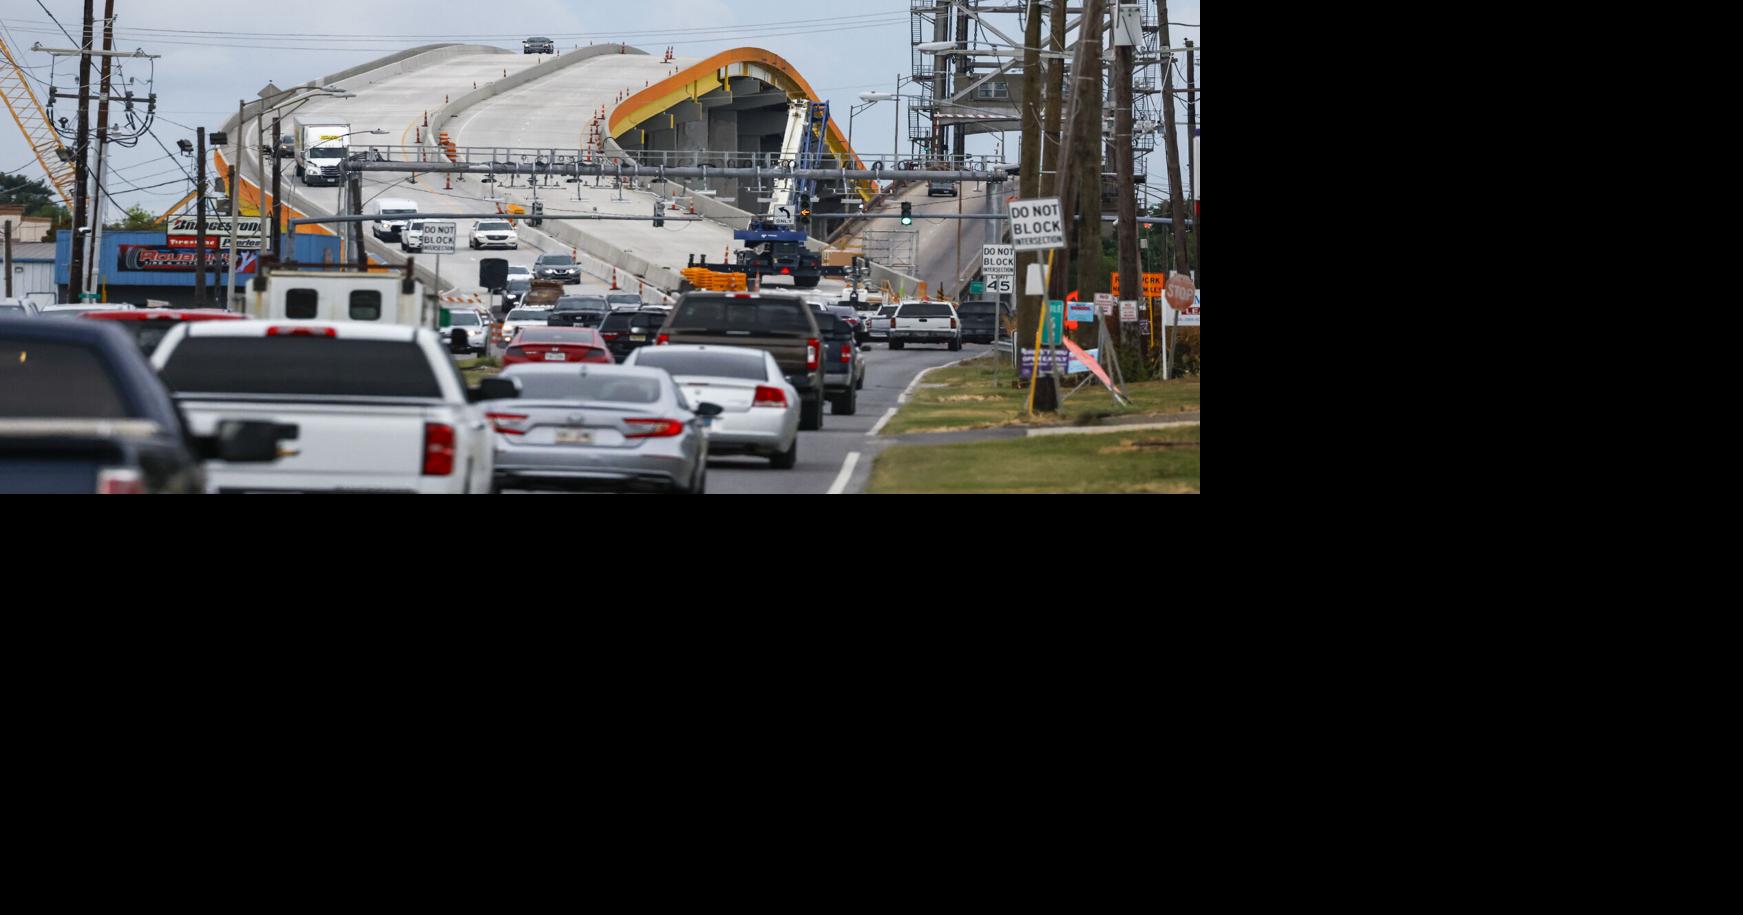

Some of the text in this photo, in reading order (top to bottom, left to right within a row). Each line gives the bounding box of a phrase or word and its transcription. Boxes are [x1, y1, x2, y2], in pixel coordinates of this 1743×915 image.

[1011, 204, 1058, 219] DO NOT
[1013, 220, 1062, 235] BLOCK
[1015, 235, 1062, 246] INTERSECTION
[983, 247, 1014, 256] DO NOT
[983, 257, 1014, 266] BLOCK
[987, 280, 1010, 292] 45
[1166, 284, 1194, 300] STOP
